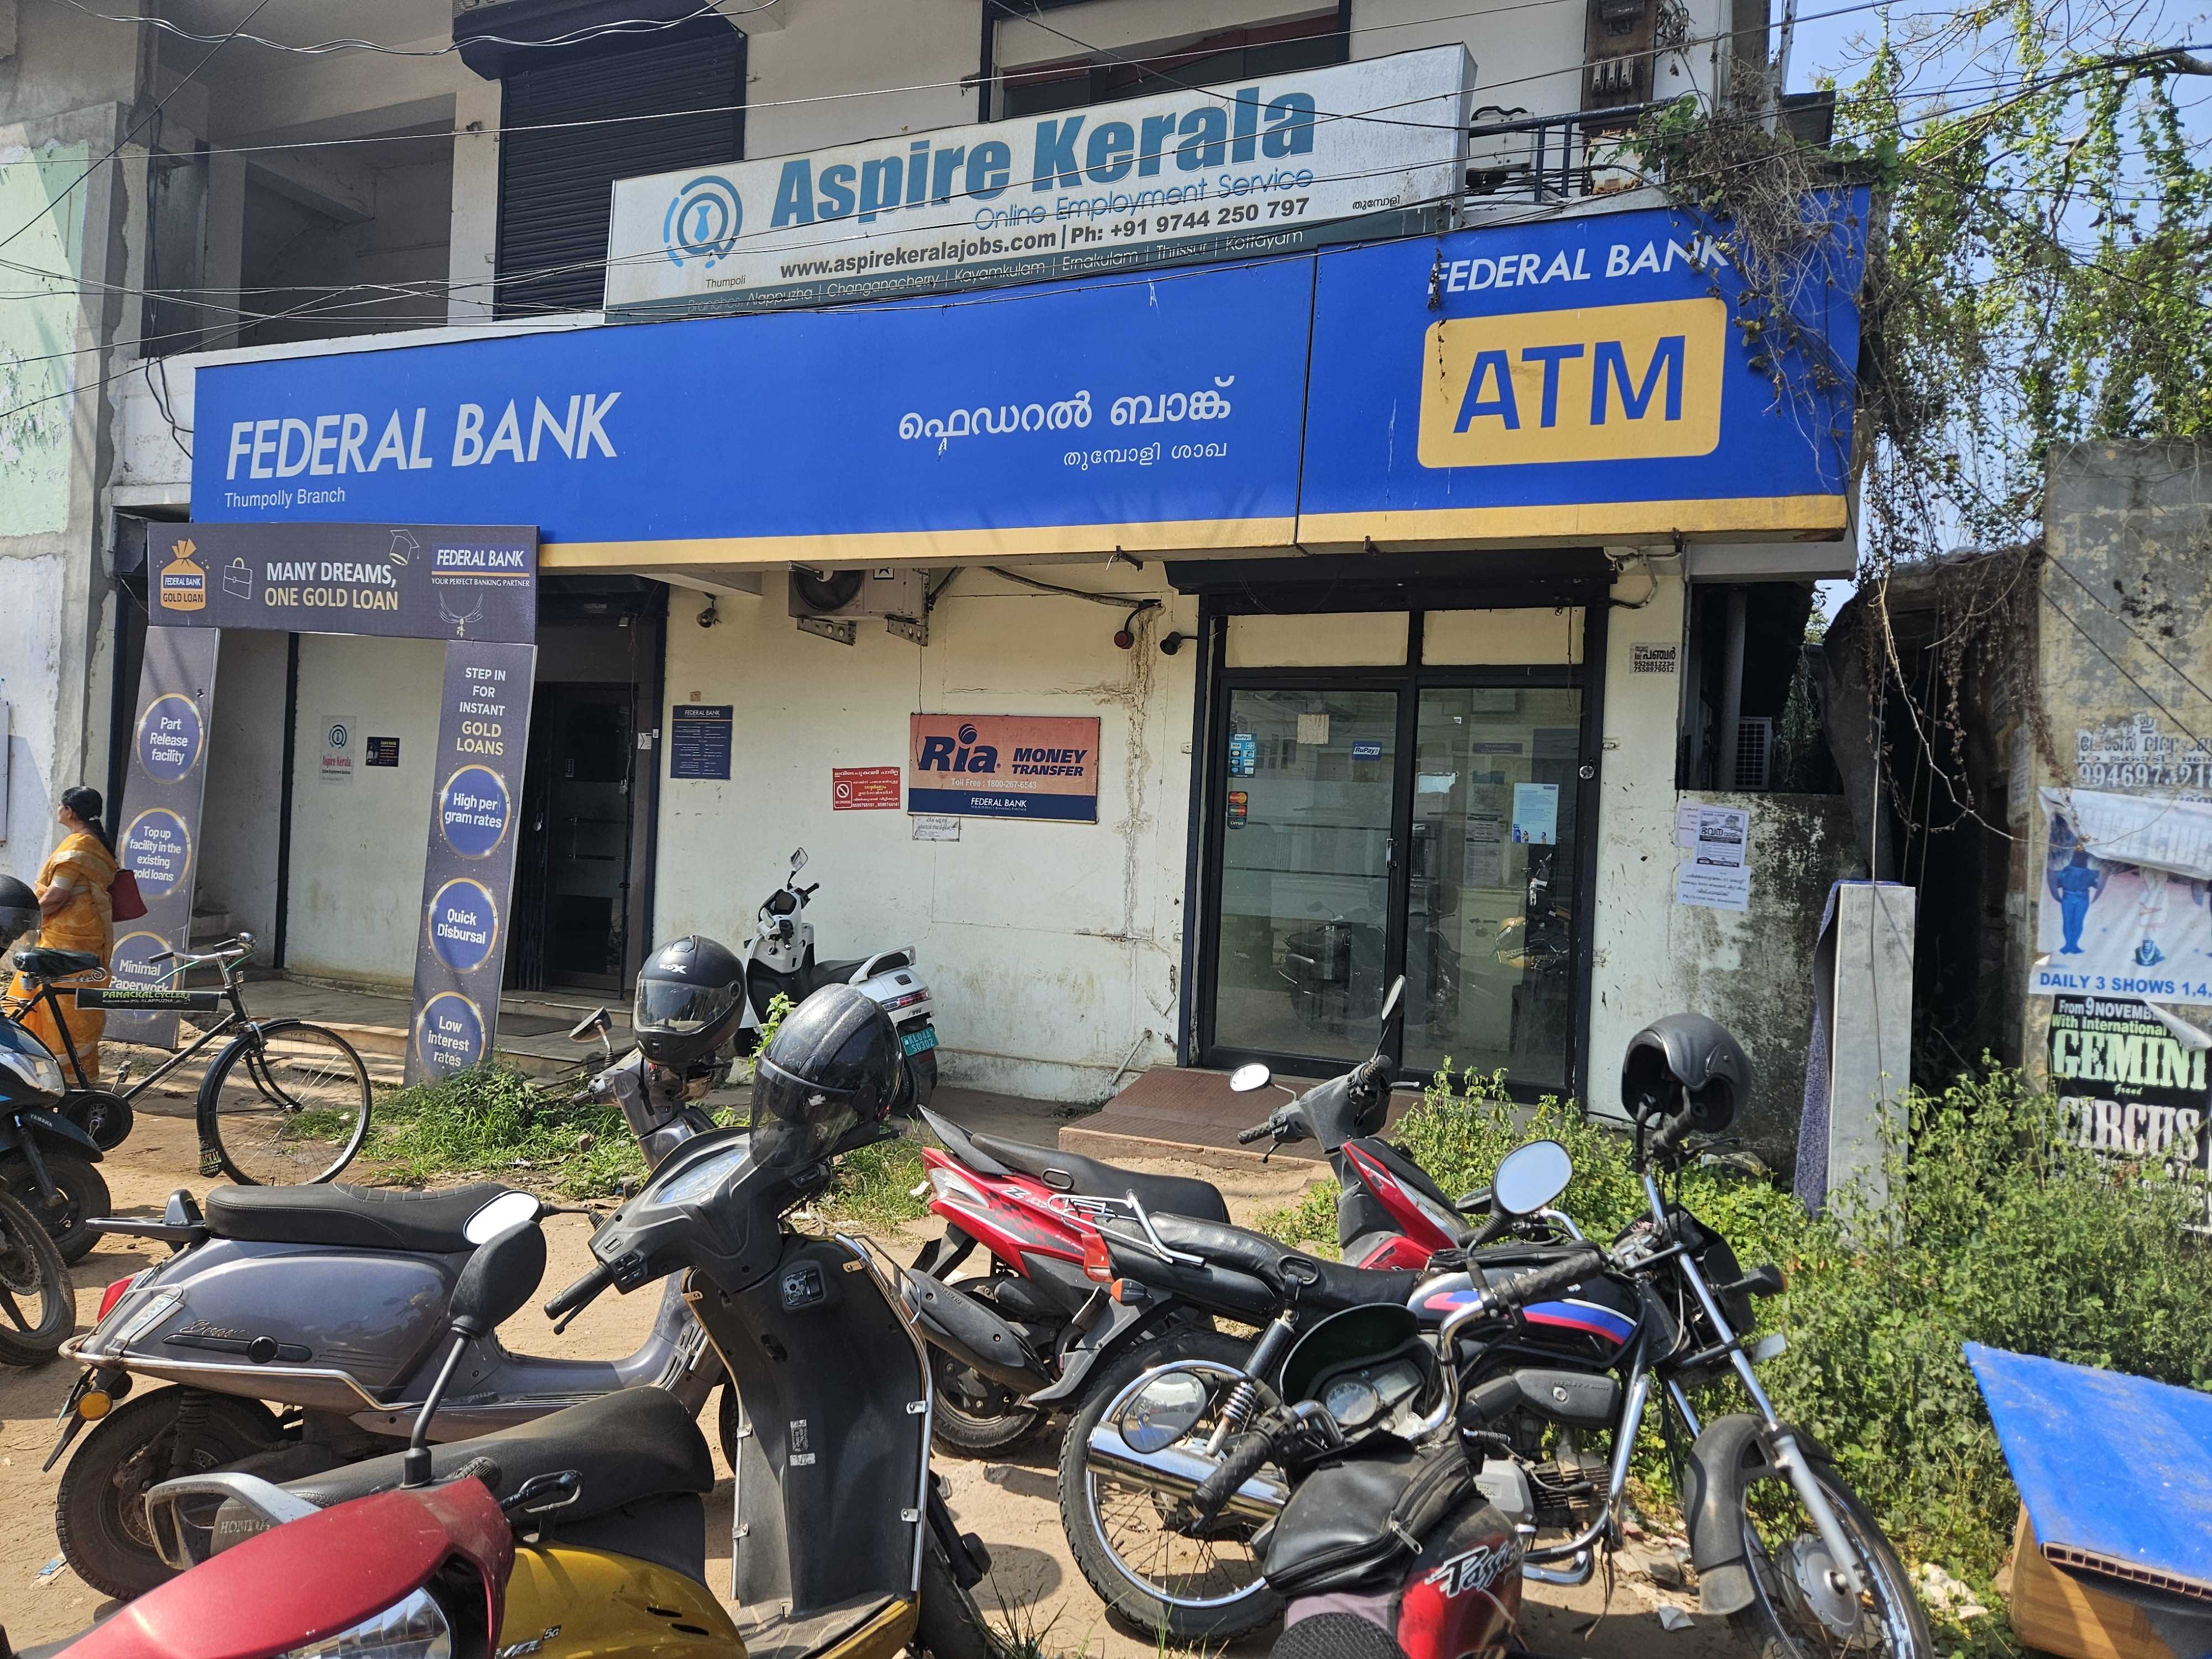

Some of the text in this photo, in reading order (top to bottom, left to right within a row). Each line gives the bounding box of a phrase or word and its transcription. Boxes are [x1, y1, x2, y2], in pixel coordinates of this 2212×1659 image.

[770, 86, 1316, 228] Aspire Kerala
[974, 168, 1313, 231] Online Employment Service
[780, 232, 1056, 278] www.aspirekeralajobs.com
[1071, 225, 1103, 244] Ph:
[1111, 218, 1147, 237] +91
[1156, 210, 1209, 233] 9744
[1218, 204, 1259, 225] 250
[1268, 197, 1310, 218] 797
[747, 287, 813, 307] Alappuzha
[828, 274, 940, 297] Changanacherry
[955, 261, 1045, 283] Kayamkulam
[1062, 249, 1138, 271] Ernakulam
[1157, 243, 1207, 259] Thrissur
[1226, 231, 1303, 252] Kottayam
[1428, 234, 1730, 294] FEDERAL BANK
[706, 275, 746, 289] Thumpoli
[1453, 335, 1686, 434] ATM
[899, 375, 1235, 440] ഫെഡറൽ ബാങ്ക്
[226, 392, 622, 480] FEDERAL BANK
[1063, 442, 1227, 471] തുമ്പോളി ശാഖ
[225, 487, 345, 510] Thumpolly Branch
[437, 549, 524, 567] FEDERAL BANK
[165, 577, 201, 586] FEDERAL BANK
[267, 561, 397, 588] MANY DREAMS,
[163, 593, 203, 603] GOLD LOAN
[264, 588, 398, 611] ONE GOLD LOAN
[465, 667, 506, 681] STEP IN
[472, 685, 495, 697] FOR
[460, 702, 505, 716] INSTANT
[160, 717, 182, 730] Part
[462, 721, 502, 737] GOLD
[150, 732, 188, 747] Release
[456, 737, 504, 756] LOANS
[919, 723, 999, 773] Ria
[152, 748, 185, 765] facility
[1013, 748, 1088, 764] MONEY
[1011, 764, 1084, 776] TRANSFER
[951, 778, 964, 786] Toll
[966, 779, 981, 787] Free
[987, 779, 1037, 789] 1800-267-6543
[453, 792, 498, 811] High per
[971, 797, 1027, 808] FEDERAL BANK
[445, 811, 502, 828] gram rates
[144, 826, 171, 841] Top up
[129, 838, 181, 854] facility in the
[137, 854, 170, 869] existing
[150, 869, 174, 881] loans
[447, 908, 477, 926] Quick
[437, 923, 486, 945] Disbursal
[119, 959, 161, 976] Minimal
[109, 975, 170, 993] Paperwork
[2040, 972, 2091, 989] DAILY
[2096, 976, 2105, 989] 3
[2111, 977, 2175, 994] SHOWS
[2059, 997, 2157, 1021] From 9 NOVEMB
[439, 1016, 462, 1034] Low
[2052, 1014, 2167, 1037] With International
[428, 1030, 469, 1052] interest
[433, 1051, 462, 1067] rates
[2053, 1030, 2207, 1091] GEMINI
[2114, 1083, 2142, 1095] Grand
[30, 1113, 53, 1128] YAMAHA
[2059, 1096, 2200, 1161] CIRCUS
